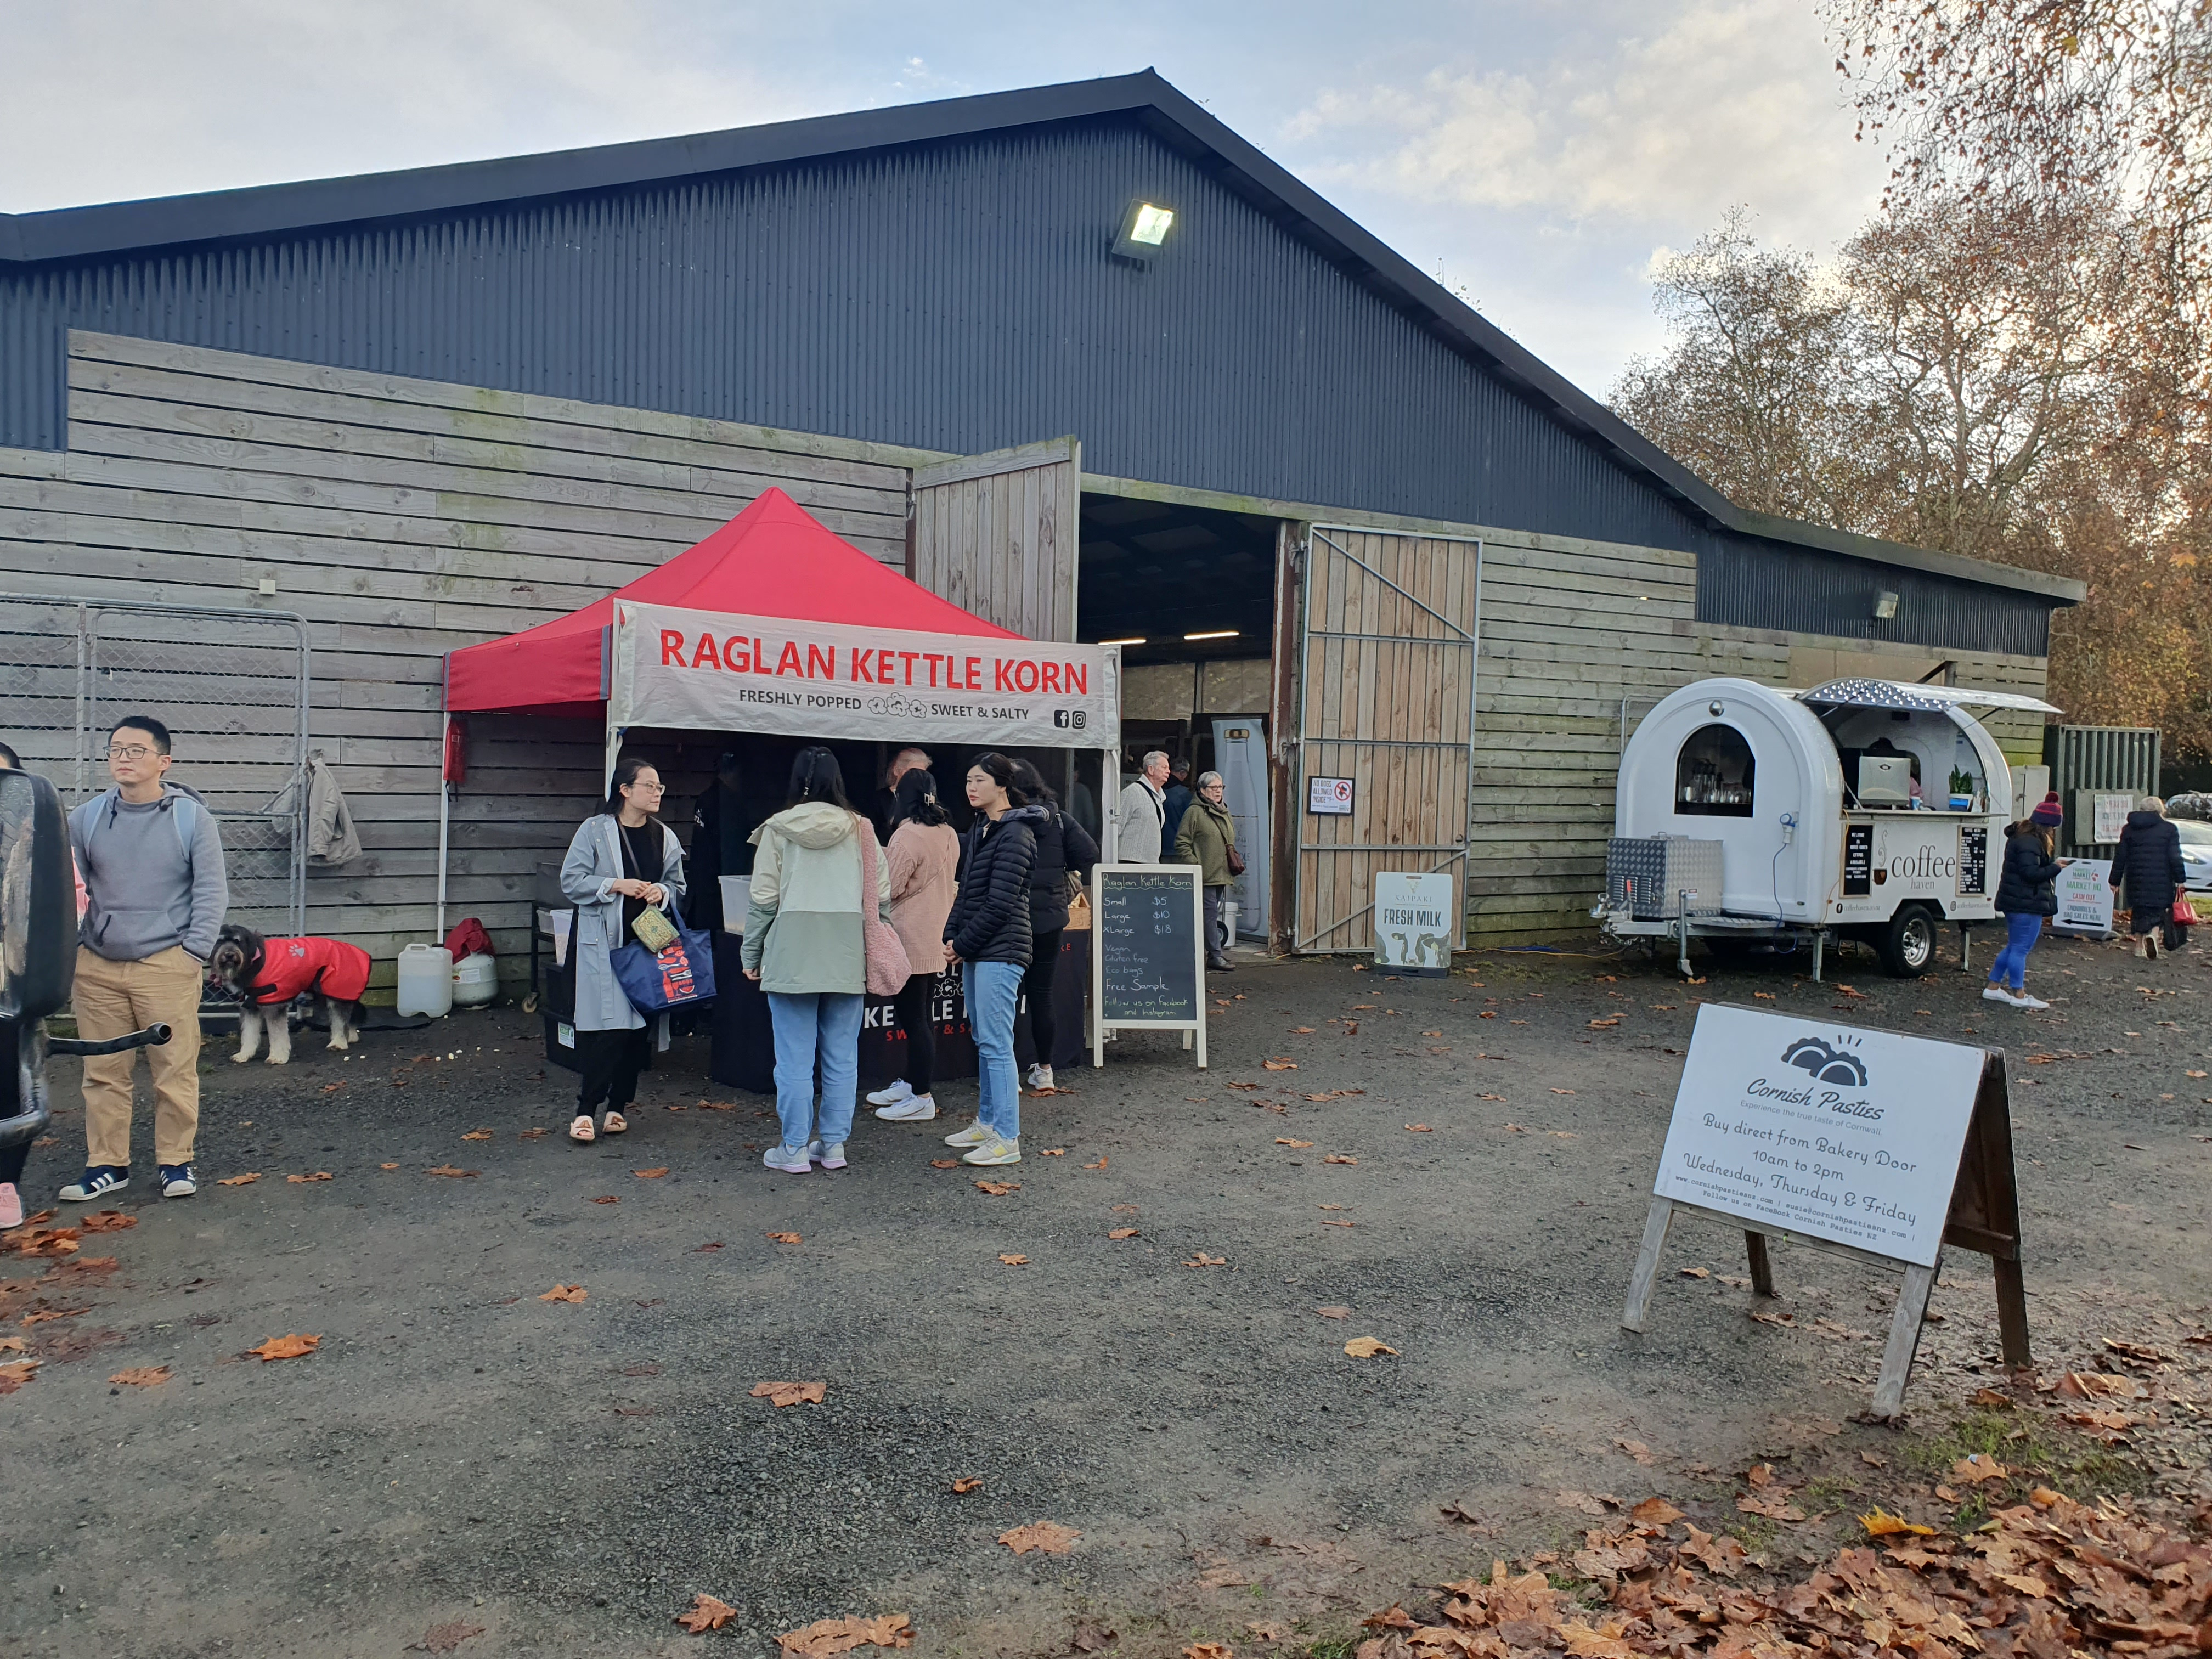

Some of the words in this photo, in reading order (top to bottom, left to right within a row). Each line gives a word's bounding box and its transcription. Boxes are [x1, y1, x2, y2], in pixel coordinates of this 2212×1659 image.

[660, 629, 835, 680] RAGLAN
[851, 647, 982, 690] KETTLE
[995, 658, 1087, 695] KORN
[739, 689, 802, 706] FRESHLY
[806, 694, 862, 710] POPPED
[931, 703, 973, 718] SWEET
[977, 706, 989, 718] &
[991, 707, 1029, 720] SALTY
[1891, 845, 1956, 878] coffee
[1103, 873, 1137, 891] Raglan
[1141, 874, 1165, 887] Kettle
[1169, 874, 1192, 887] Korn
[1910, 877, 1935, 890] haven
[2066, 881, 2090, 890] MARKET
[2092, 883, 2102, 891] HQ
[1103, 896, 1126, 906] Small
[1152, 896, 1167, 906] $5
[1105, 913, 1131, 923] Large
[1153, 910, 1170, 919] $10
[1384, 909, 1413, 926] FRESH
[1416, 910, 1442, 927] MILK
[1103, 926, 1135, 936] XLarge
[1154, 924, 1172, 935] $18
[1105, 944, 1131, 954] Vegan
[1105, 966, 1120, 974] Eco
[1123, 966, 1144, 978] bags
[1105, 978, 1127, 990] Free
[1130, 975, 1169, 992] Sample
[1105, 996, 1129, 1006] Follow
[865, 1000, 953, 1029] KELE
[1142, 1008, 1176, 1018] Instagram
[943, 1024, 955, 1035] &
[1747, 1078, 1814, 1106] Cornish
[1817, 1091, 1885, 1120] Pasties
[1740, 1100, 1780, 1114] Experience
[1782, 1108, 1795, 1117] the
[1797, 1112, 1812, 1120] true
[1814, 1115, 1833, 1125] taste
[1703, 1113, 1729, 1135] Buy
[1734, 1120, 1773, 1141] direct
[1776, 1128, 1809, 1149] from
[1815, 1137, 1868, 1165] Bakery
[1875, 1150, 1917, 1172] Door
[1753, 1150, 1788, 1168] 10am
[1794, 1159, 1808, 1172] to
[1813, 1163, 1844, 1180] 2pm
[1683, 1153, 1763, 1188] Wednesday,
[1770, 1174, 1838, 1207] Thursday
[1844, 1192, 1857, 1206] &
[1863, 1196, 1916, 1227] Friday
[1675, 1175, 1774, 1204] www.cornishpastiesnz.com
[1786, 1202, 1907, 1239] susie@cornishpastiesnz.com
[1702, 1190, 1728, 1201] Follow
[1756, 1204, 1791, 1218] FaceBook
[1794, 1214, 1826, 1227] Cornish
[1830, 1223, 1863, 1237] Pasties
[1866, 1233, 1877, 1241] NZ
